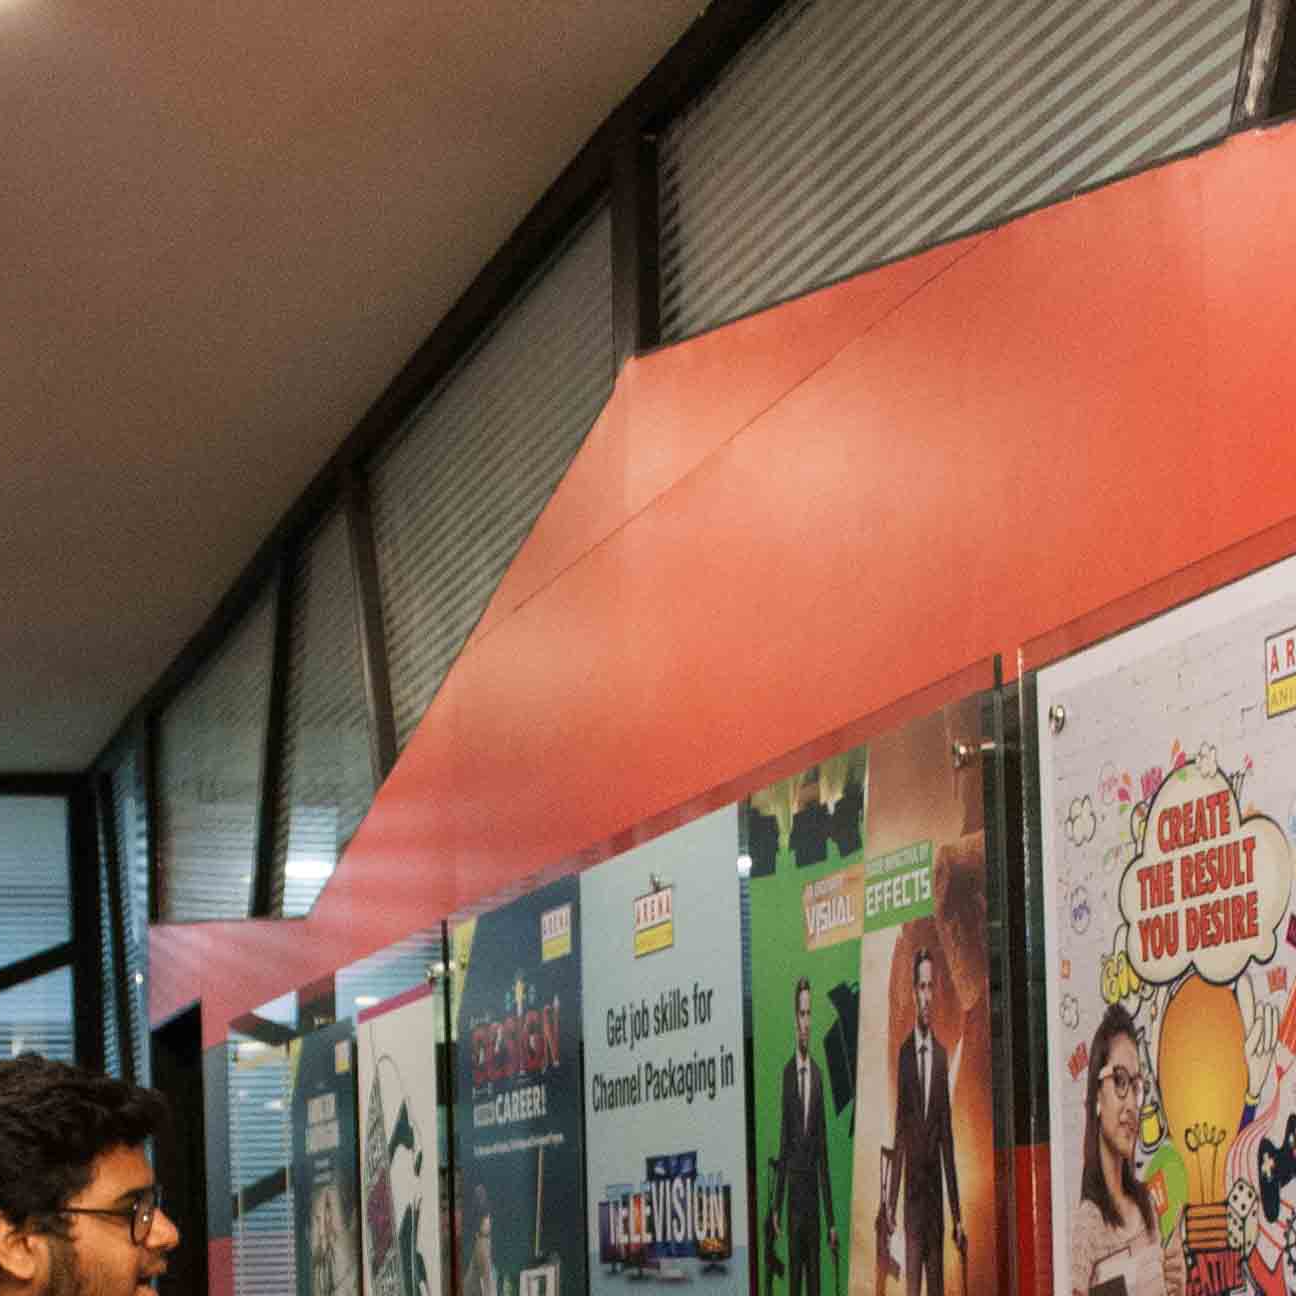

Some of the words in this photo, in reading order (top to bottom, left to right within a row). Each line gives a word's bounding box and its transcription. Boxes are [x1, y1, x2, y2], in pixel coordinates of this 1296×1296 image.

[1158, 790, 1230, 854] CREATE
[865, 866, 931, 918] EFFECTS
[1136, 860, 1174, 911] THE
[1180, 836, 1256, 900] RESULT
[1137, 910, 1180, 962] YOU
[1184, 890, 1259, 952] DESIRE
[606, 1006, 627, 1047] Get
[629, 1000, 650, 1050] job
[654, 987, 689, 1037] skills
[693, 981, 713, 1025] for
[592, 1064, 642, 1112] Channel
[645, 1050, 716, 1105] Packaging
[721, 1045, 734, 1088] in
